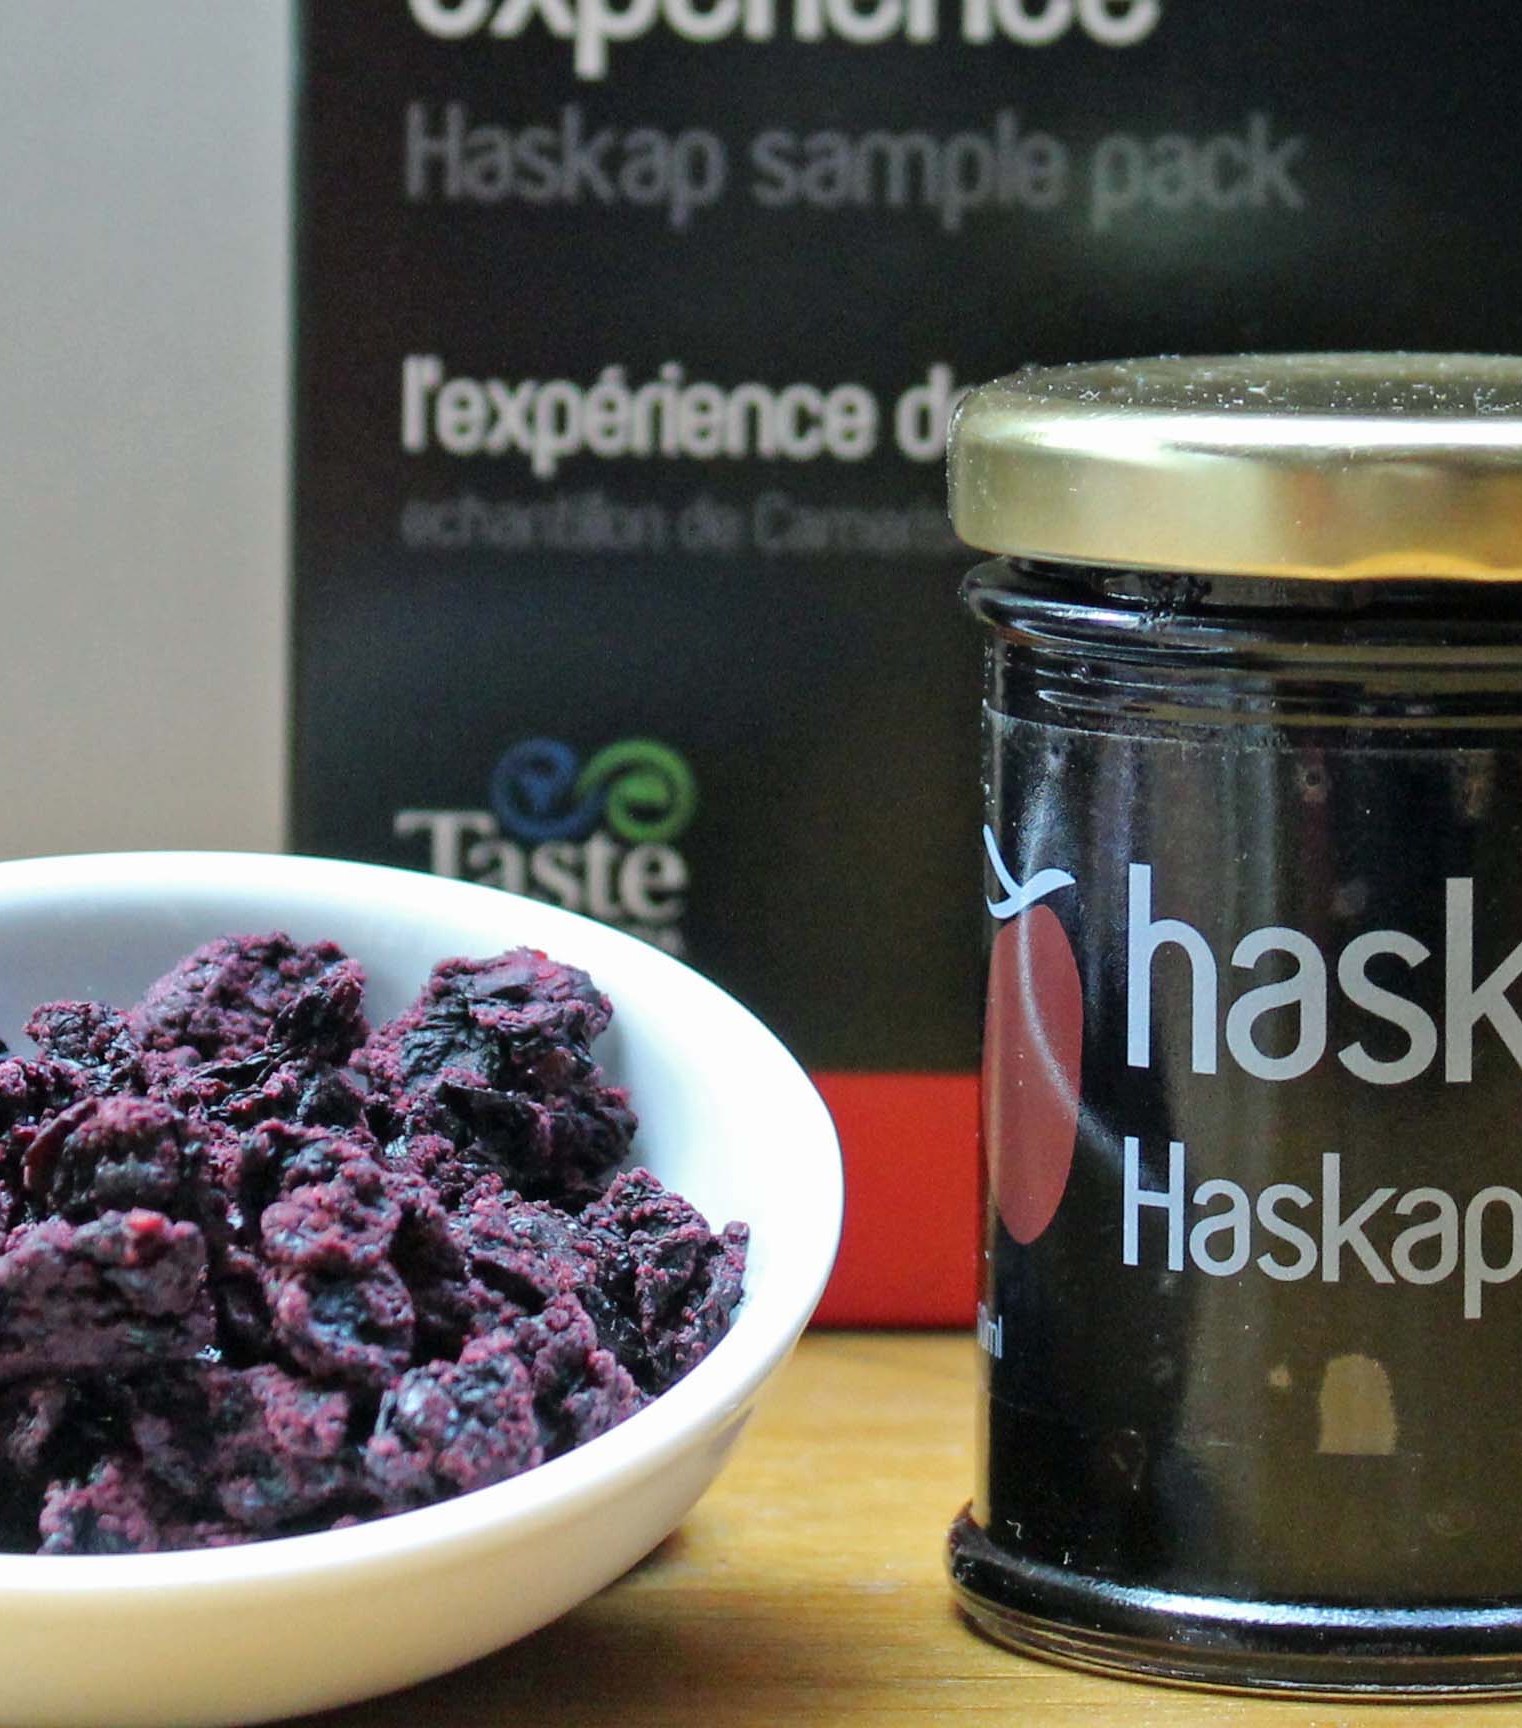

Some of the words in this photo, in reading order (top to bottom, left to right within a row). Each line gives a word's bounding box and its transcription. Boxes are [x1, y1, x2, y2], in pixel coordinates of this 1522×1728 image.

[403, 102, 726, 232] Haskap
[749, 108, 1069, 232] sample
[1089, 110, 1307, 232] pack
[393, 809, 689, 922] Taste
